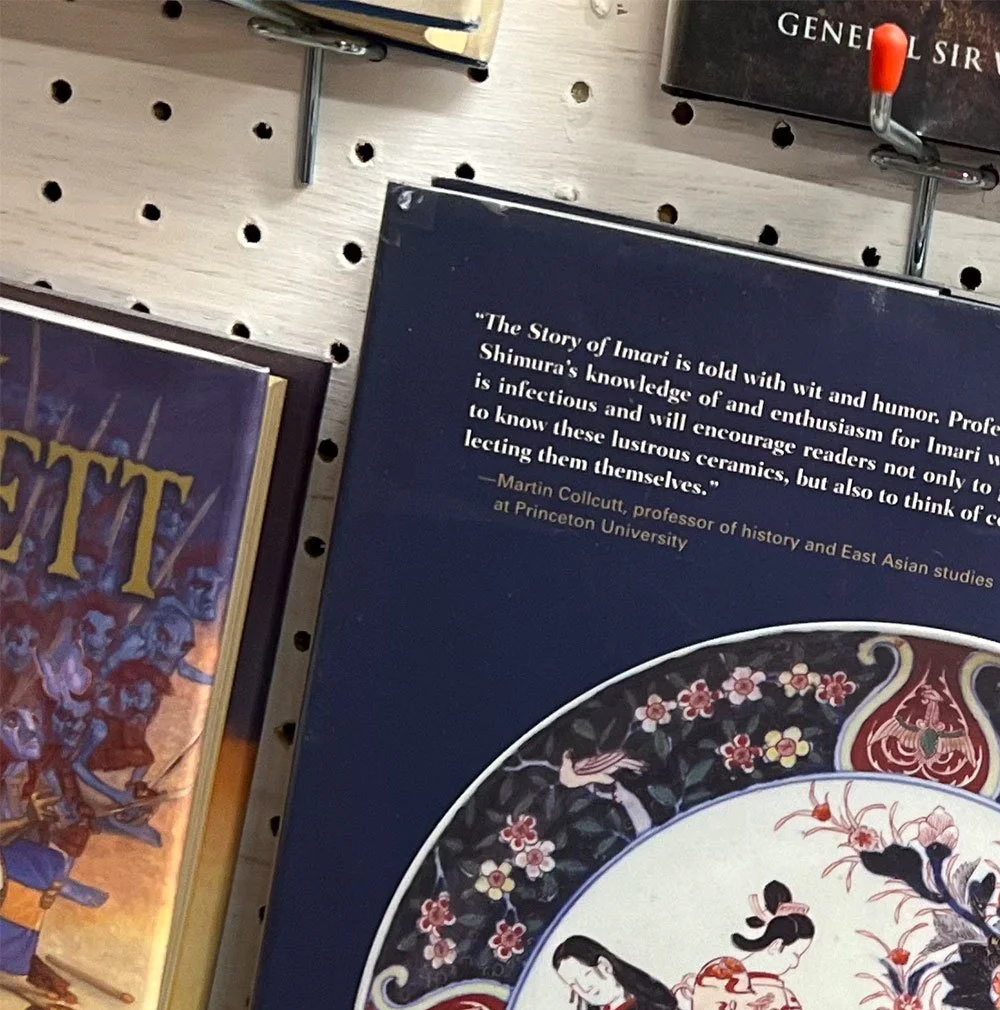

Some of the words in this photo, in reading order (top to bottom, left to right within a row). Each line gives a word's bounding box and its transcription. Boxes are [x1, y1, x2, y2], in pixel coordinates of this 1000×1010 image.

[777, 12, 921, 60] GENEL
[932, 40, 983, 72] SIR
[527, 322, 583, 353] Story
[586, 336, 613, 358] of
[612, 340, 671, 368] Imari
[675, 353, 692, 372] is
[698, 360, 739, 383] told
[743, 371, 786, 393] with
[793, 381, 824, 400] wit
[828, 390, 867, 409] and
[871, 393, 940, 425] humor.
[464, 428, 533, 465] lecting
[537, 445, 588, 472] them
[474, 372, 491, 391] is
[498, 376, 598, 413] infectious
[604, 403, 644, 423] and
[649, 411, 688, 432] will
[692, 423, 797, 457] encourage
[803, 445, 877, 472] readers
[883, 462, 917, 480] not
[922, 469, 967, 494] only
[972, 478, 993, 496] to
[493, 500, 511, 514] at
[514, 501, 596, 533] Princeton
[601, 518, 689, 553] University
[558, 486, 628, 516] Collcutt,
[632, 505, 716, 532] professor
[719, 521, 739, 536] of
[741, 523, 801, 552] history
[804, 540, 838, 557] and
[841, 544, 877, 565] East
[881, 553, 929, 576] Asian
[933, 566, 994, 589] studies
